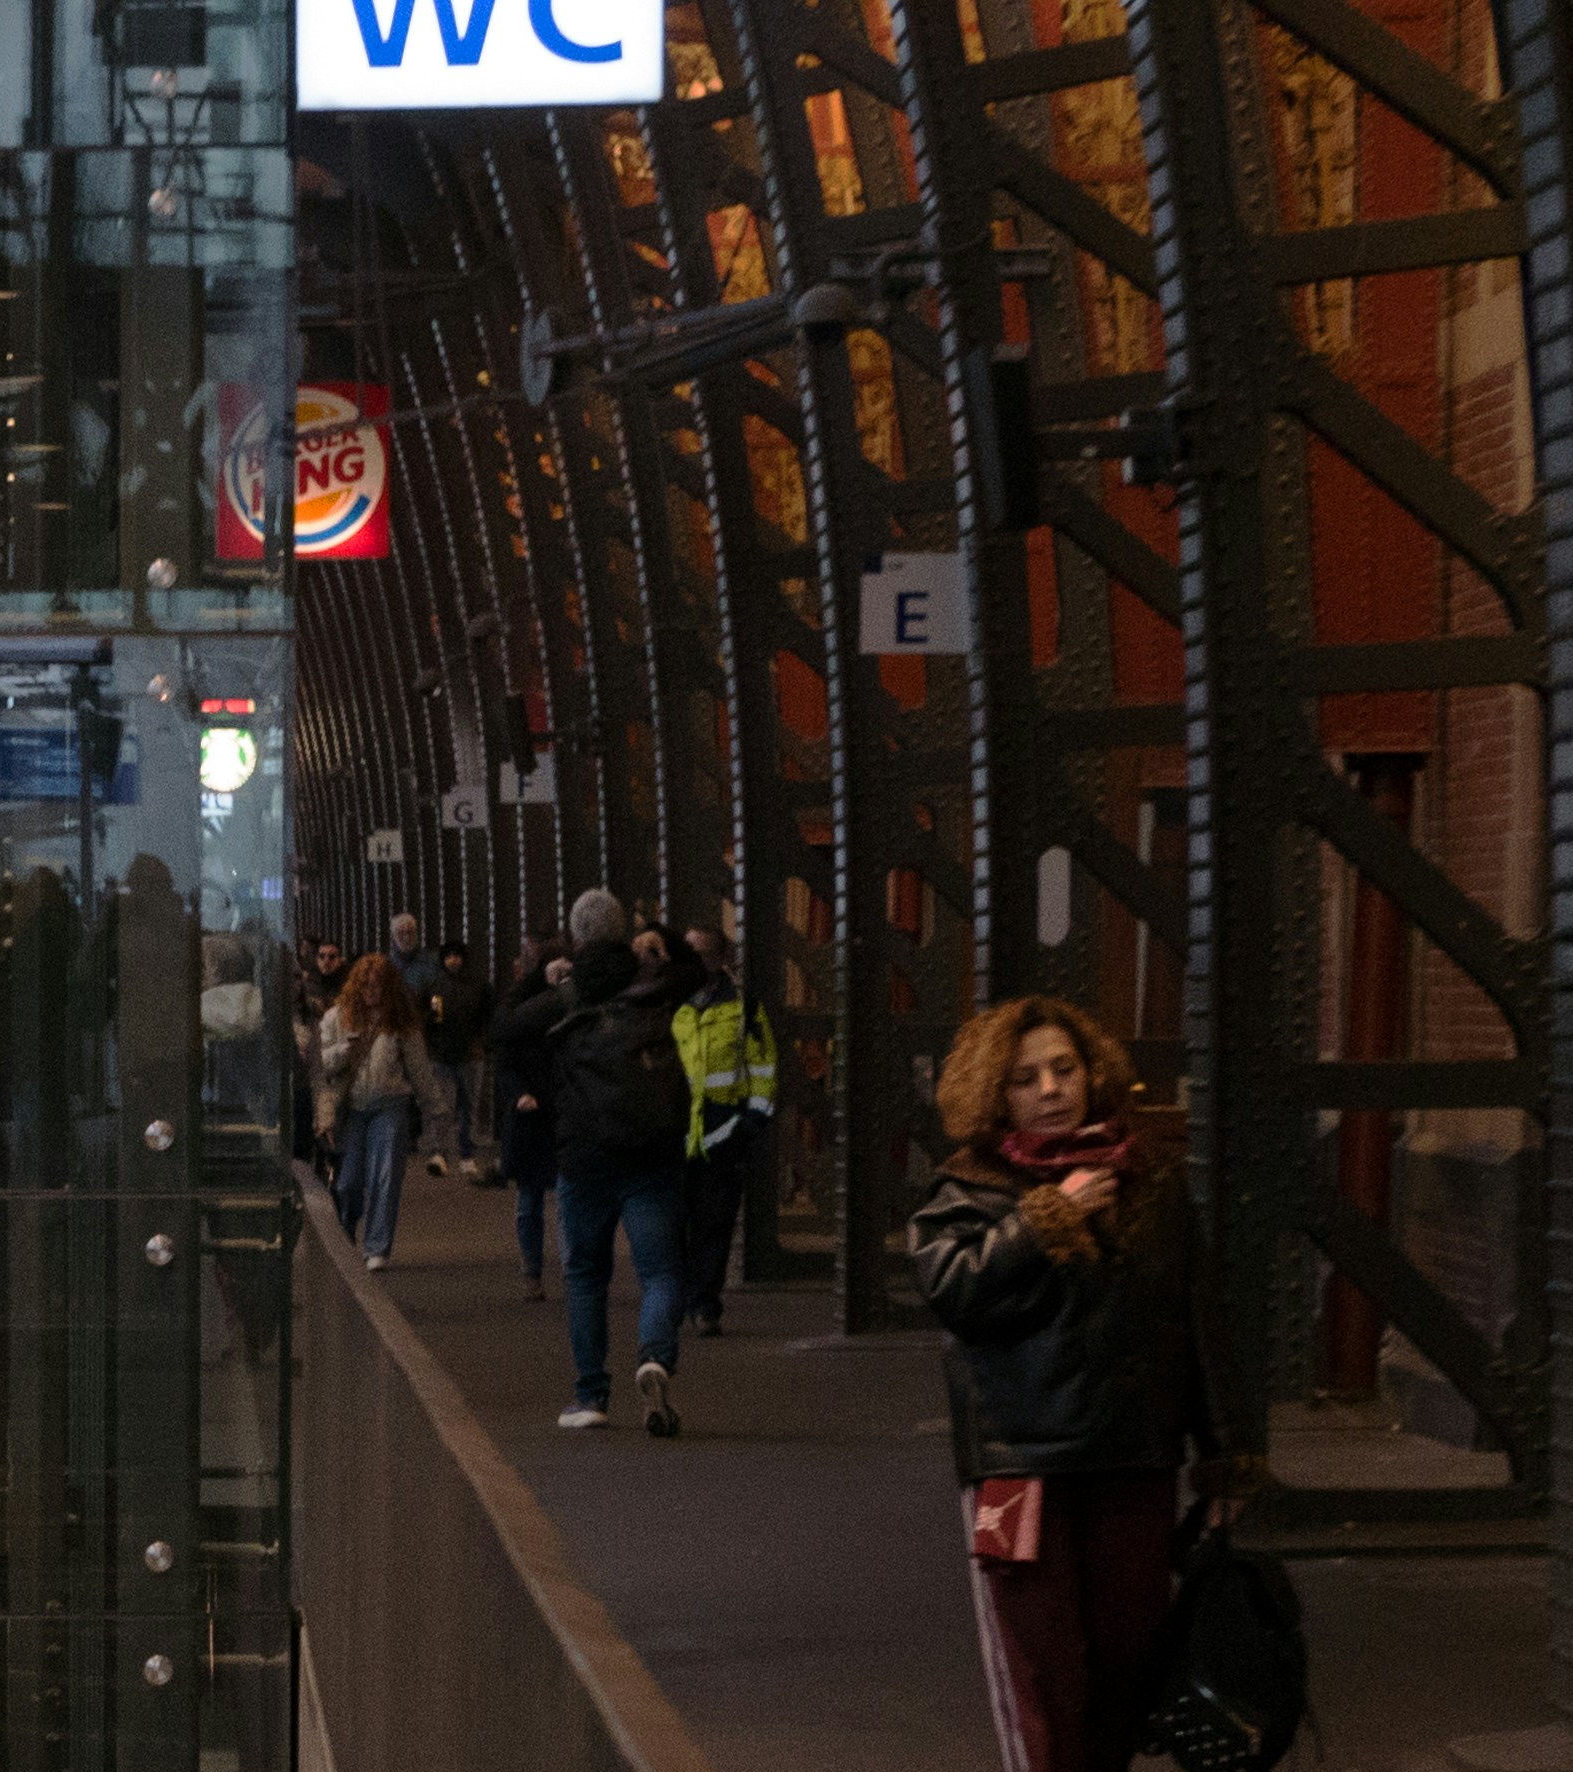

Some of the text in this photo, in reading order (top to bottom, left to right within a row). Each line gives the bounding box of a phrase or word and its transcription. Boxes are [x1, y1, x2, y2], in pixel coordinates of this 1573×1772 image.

[895, 591, 930, 645] E
[453, 801, 475, 825] G
[376, 841, 392, 858] H
